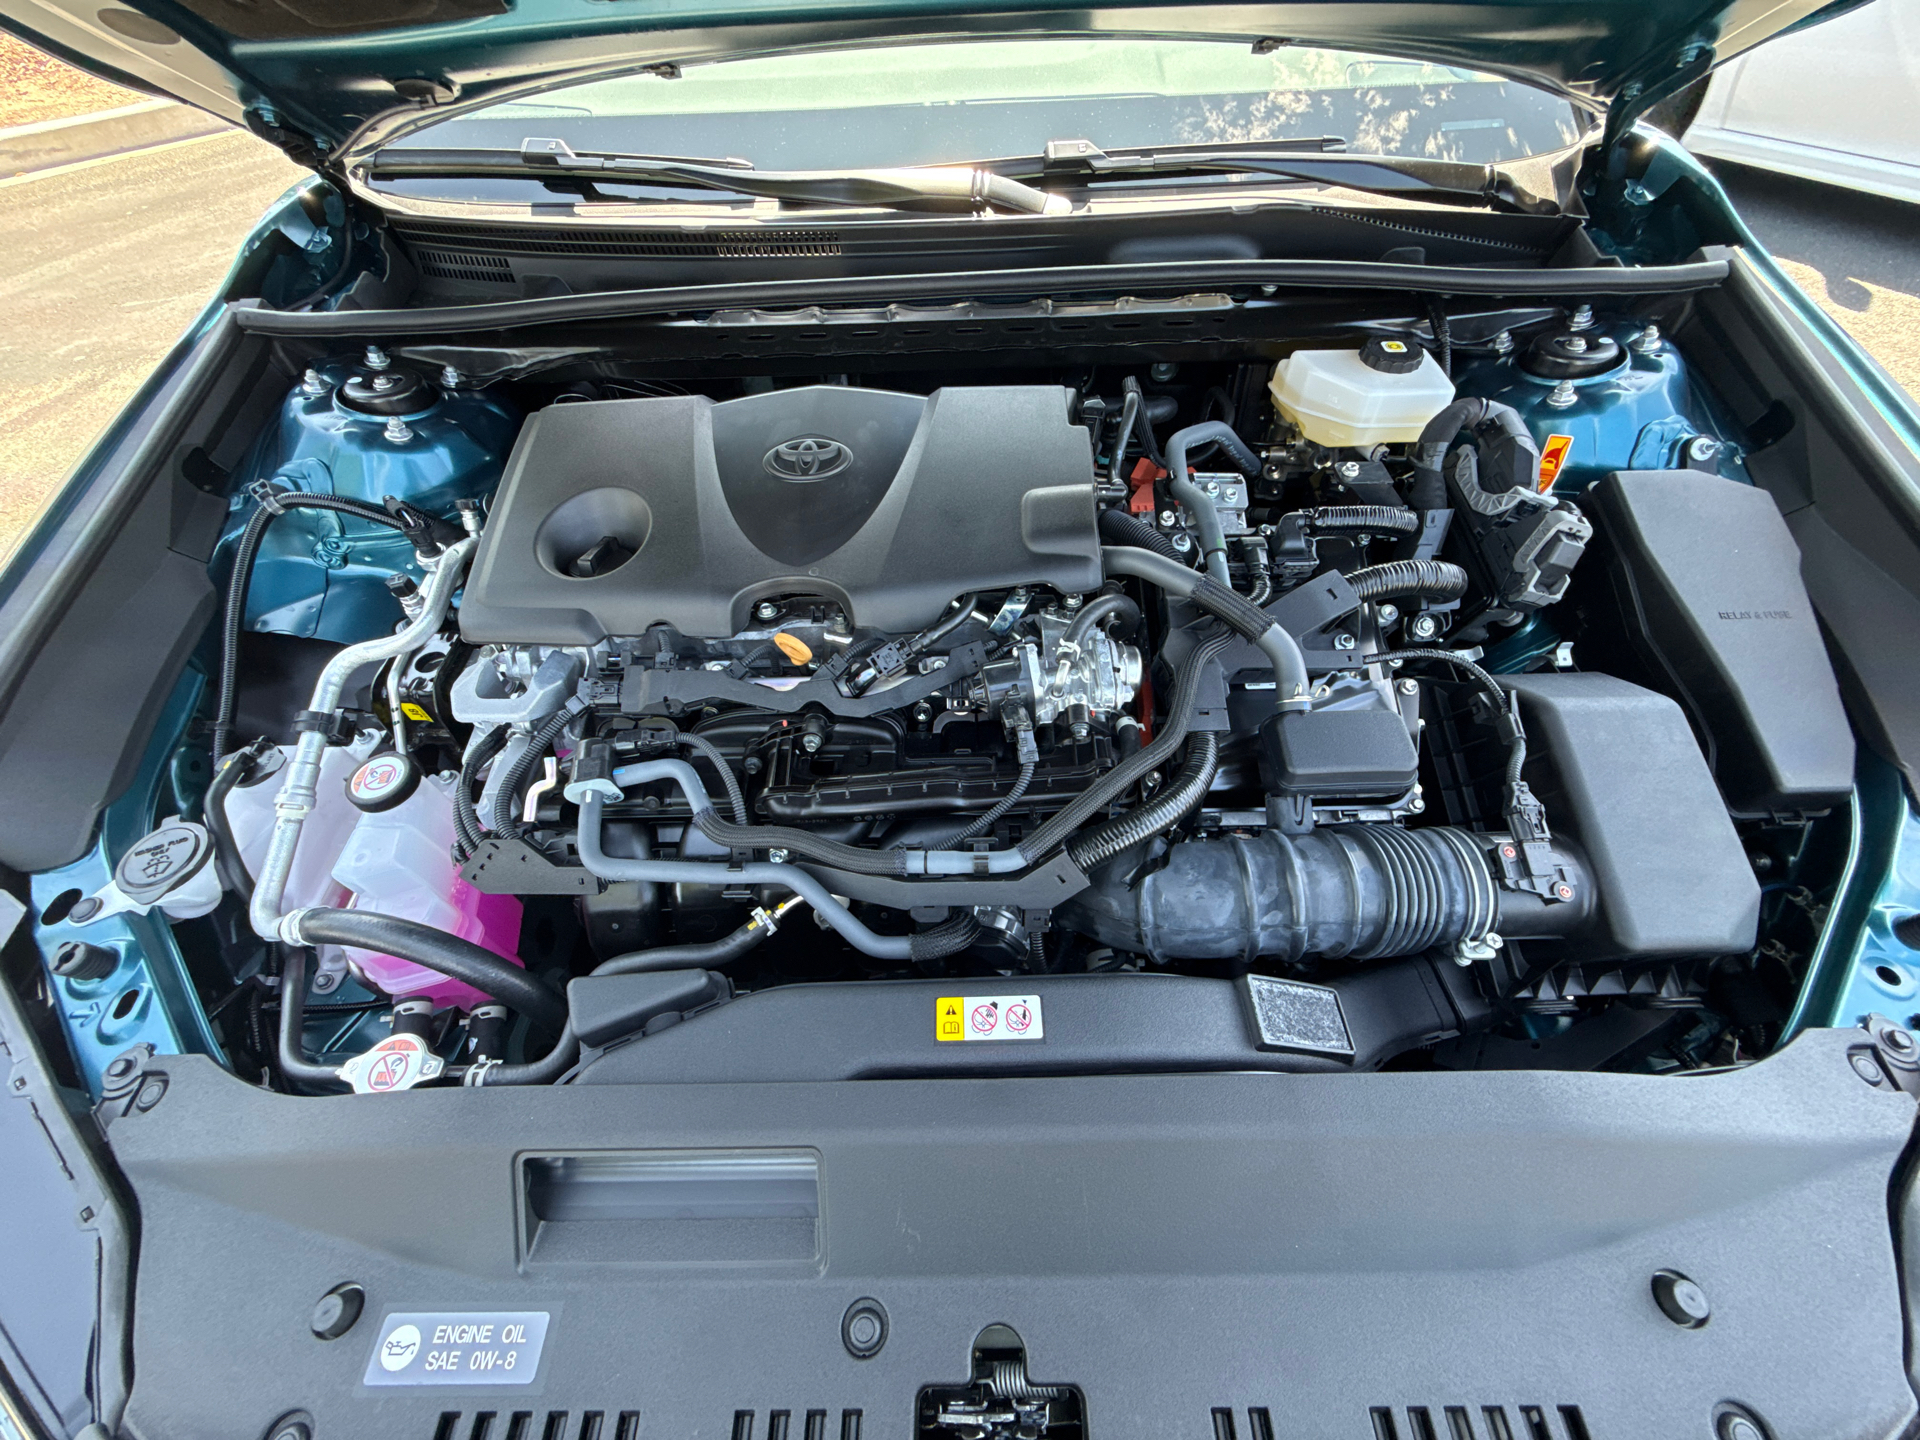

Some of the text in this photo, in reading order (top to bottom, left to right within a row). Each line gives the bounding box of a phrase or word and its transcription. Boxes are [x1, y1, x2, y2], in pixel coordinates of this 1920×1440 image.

[1718, 611, 1752, 620] RELAY
[432, 1324, 527, 1344] ENGINE OIL
[424, 1350, 517, 1371] SAE 0W-8
